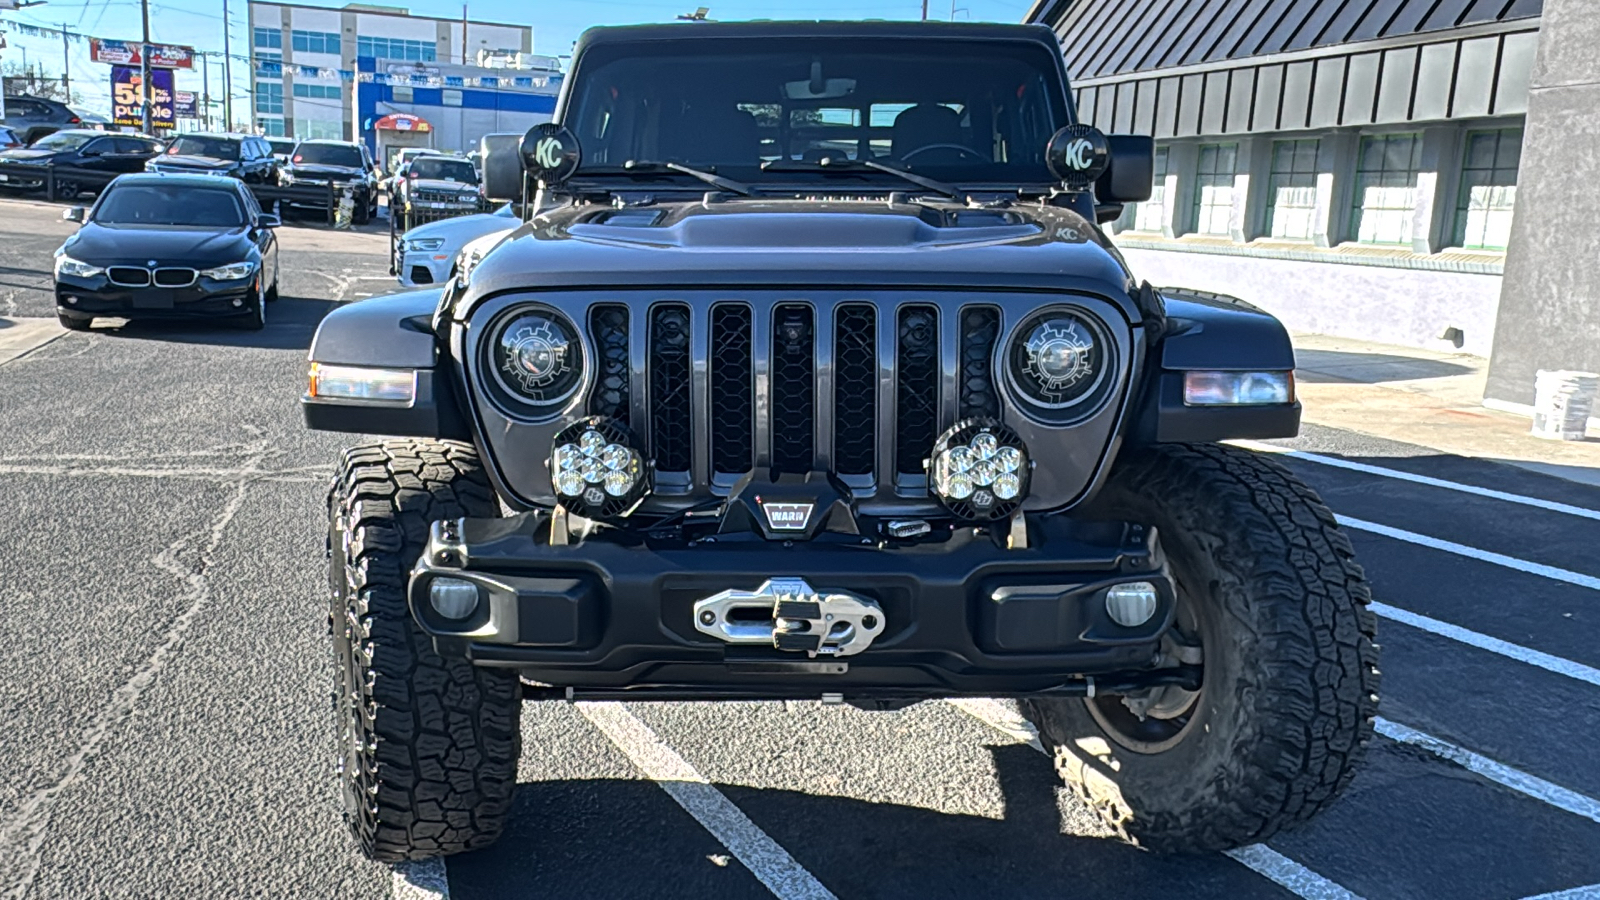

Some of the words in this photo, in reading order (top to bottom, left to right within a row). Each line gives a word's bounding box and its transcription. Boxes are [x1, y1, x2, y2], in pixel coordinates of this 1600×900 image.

[535, 137, 563, 169] KC
[1065, 138, 1094, 171] KC
[771, 511, 804, 521] WARN
